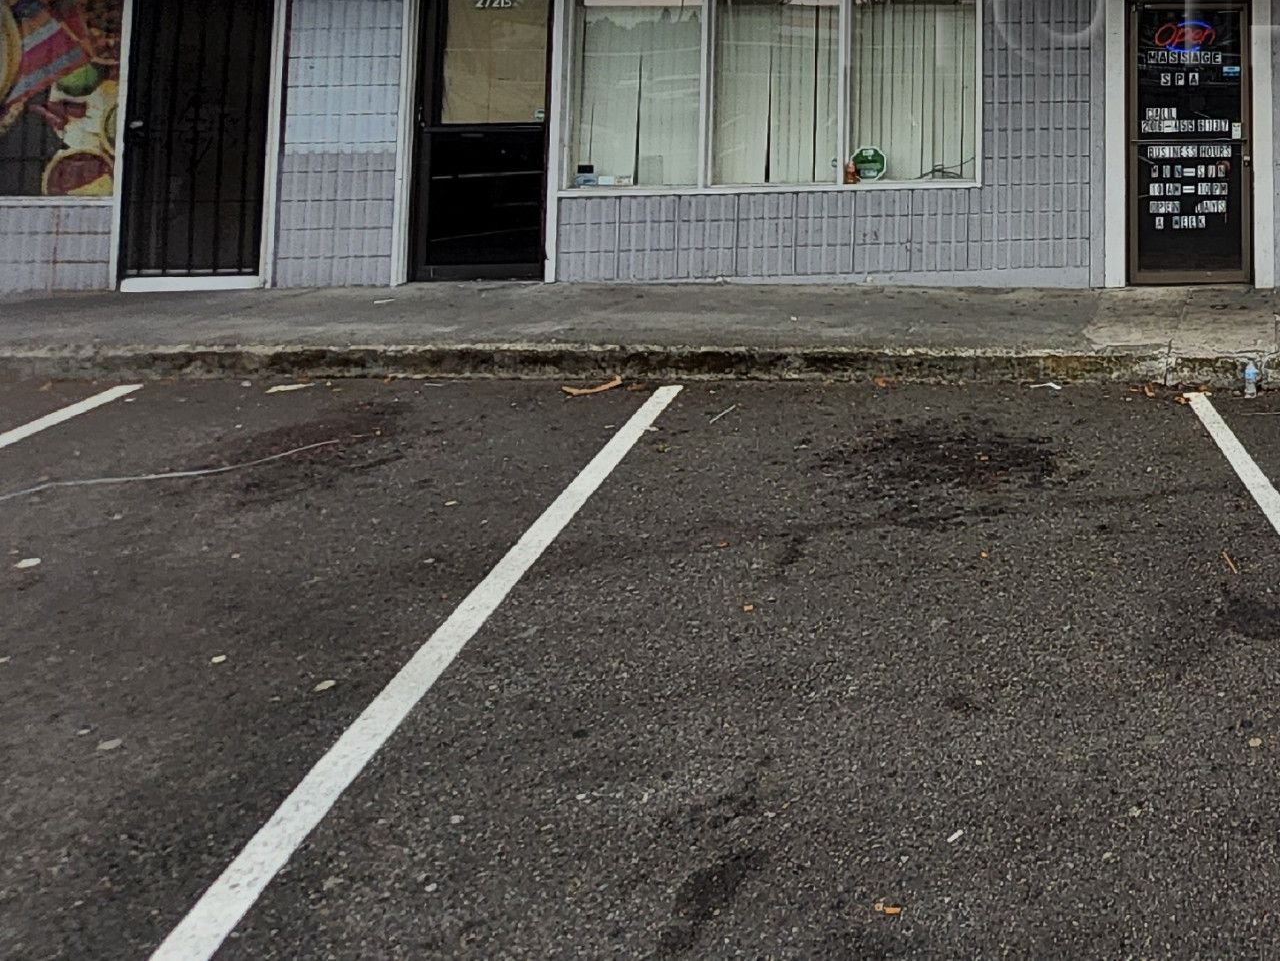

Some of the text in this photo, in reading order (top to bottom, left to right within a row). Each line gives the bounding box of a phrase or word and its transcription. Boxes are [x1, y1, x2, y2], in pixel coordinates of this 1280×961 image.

[1155, 24, 1216, 48] Open
[1148, 51, 1222, 64] MASSAGE
[1161, 73, 1199, 86] SPA
[1200, 146, 1231, 158] HOURS
